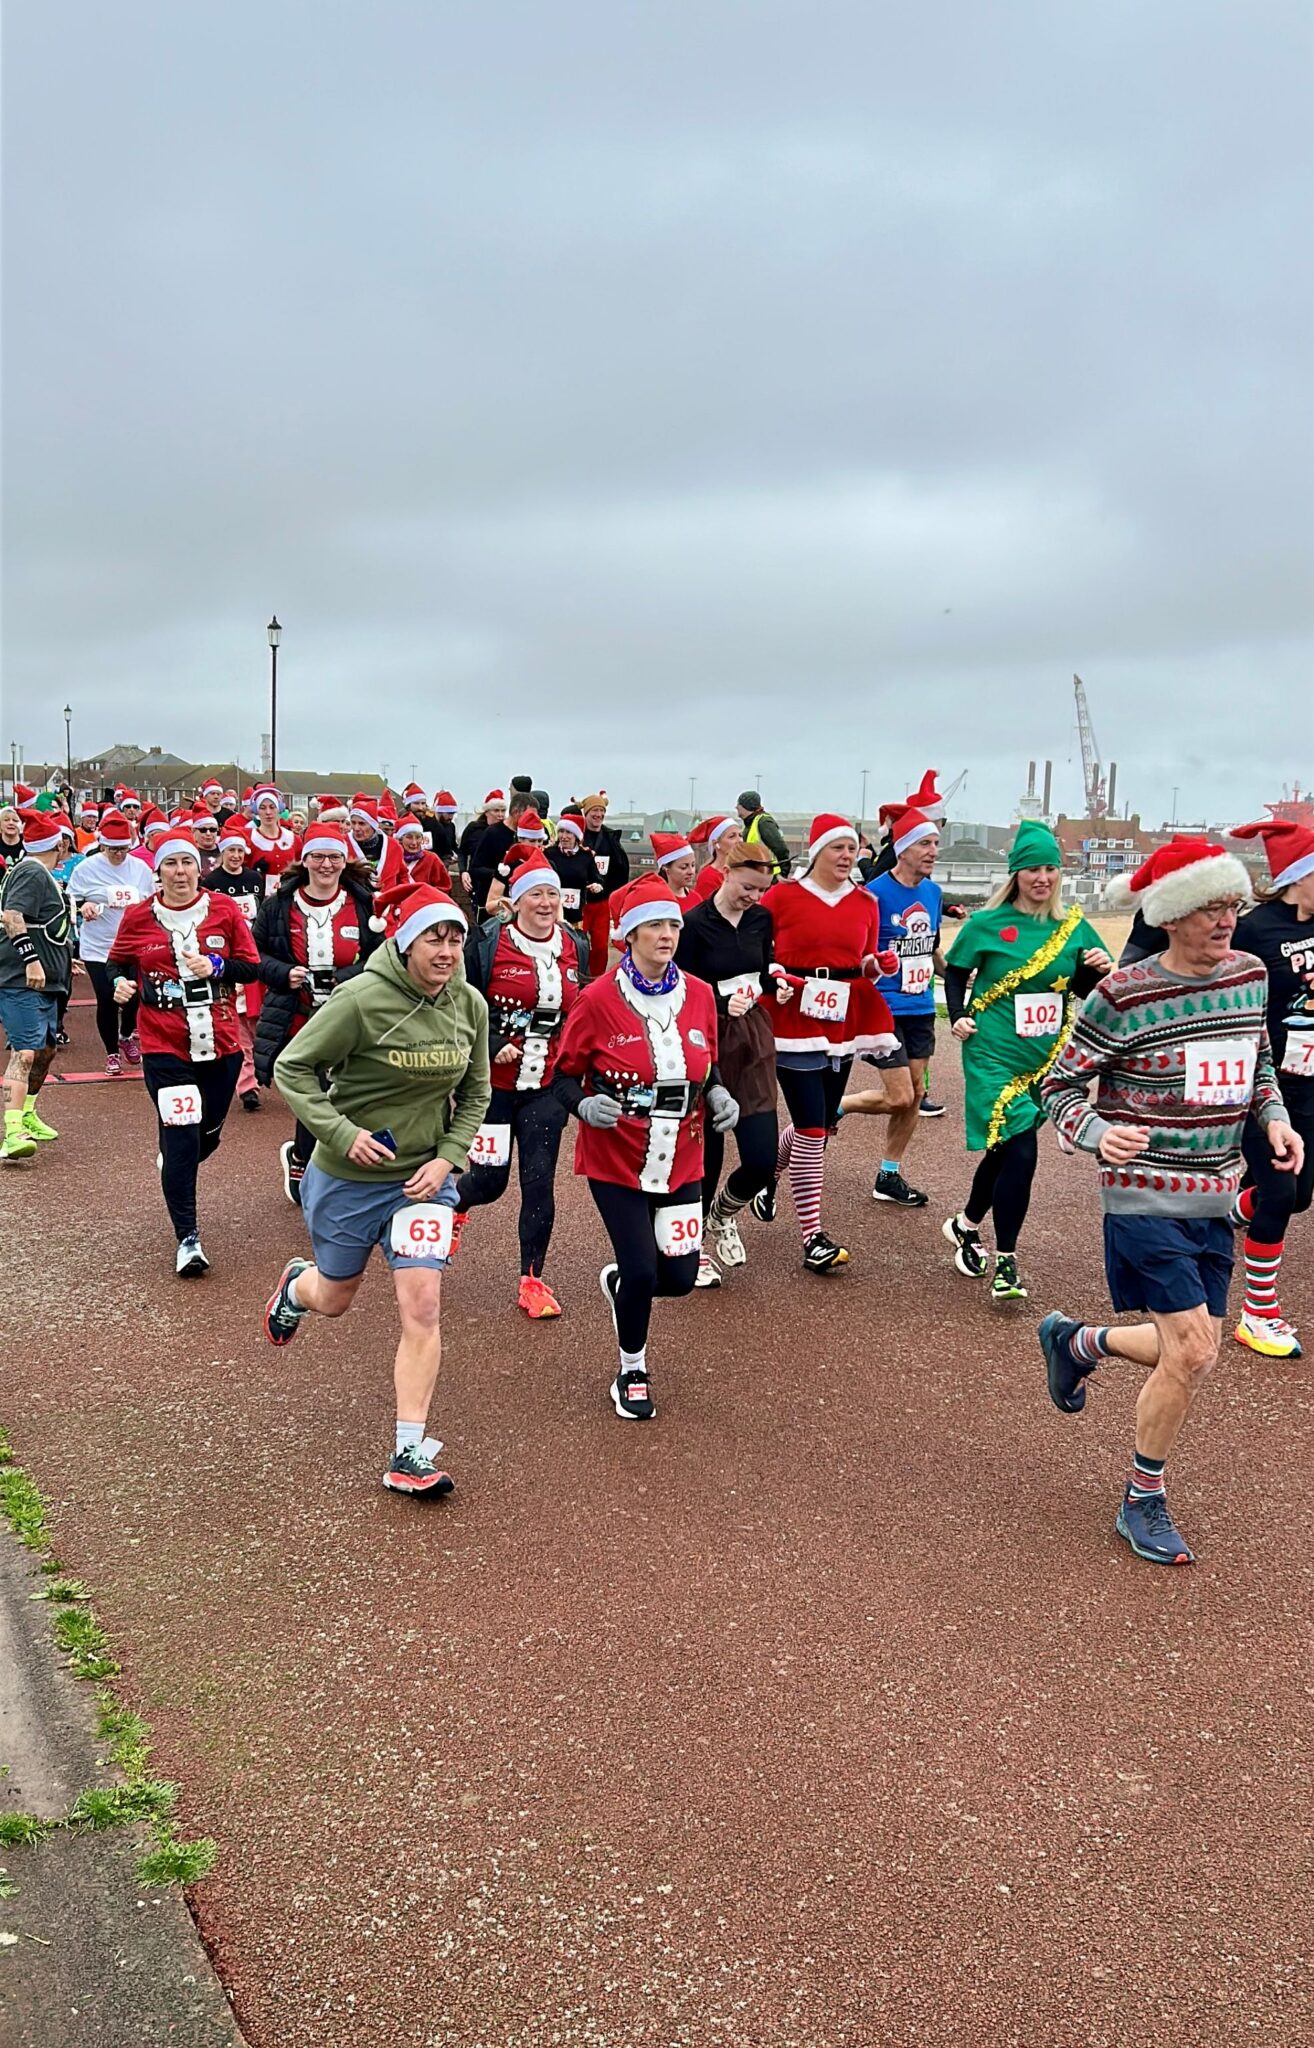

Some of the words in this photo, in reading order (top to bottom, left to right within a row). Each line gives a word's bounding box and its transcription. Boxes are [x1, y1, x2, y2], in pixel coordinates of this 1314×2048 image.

[115, 890, 132, 901] 95
[564, 894, 575, 903] 25
[908, 967, 931, 984] 104
[813, 990, 838, 1009] 46
[1024, 1004, 1058, 1024] 102
[1198, 1059, 1247, 1086] 111
[172, 1096, 196, 1115] 32
[473, 1135, 497, 1155] 31
[409, 1218, 442, 1243] 63
[671, 1218, 699, 1242] 30
